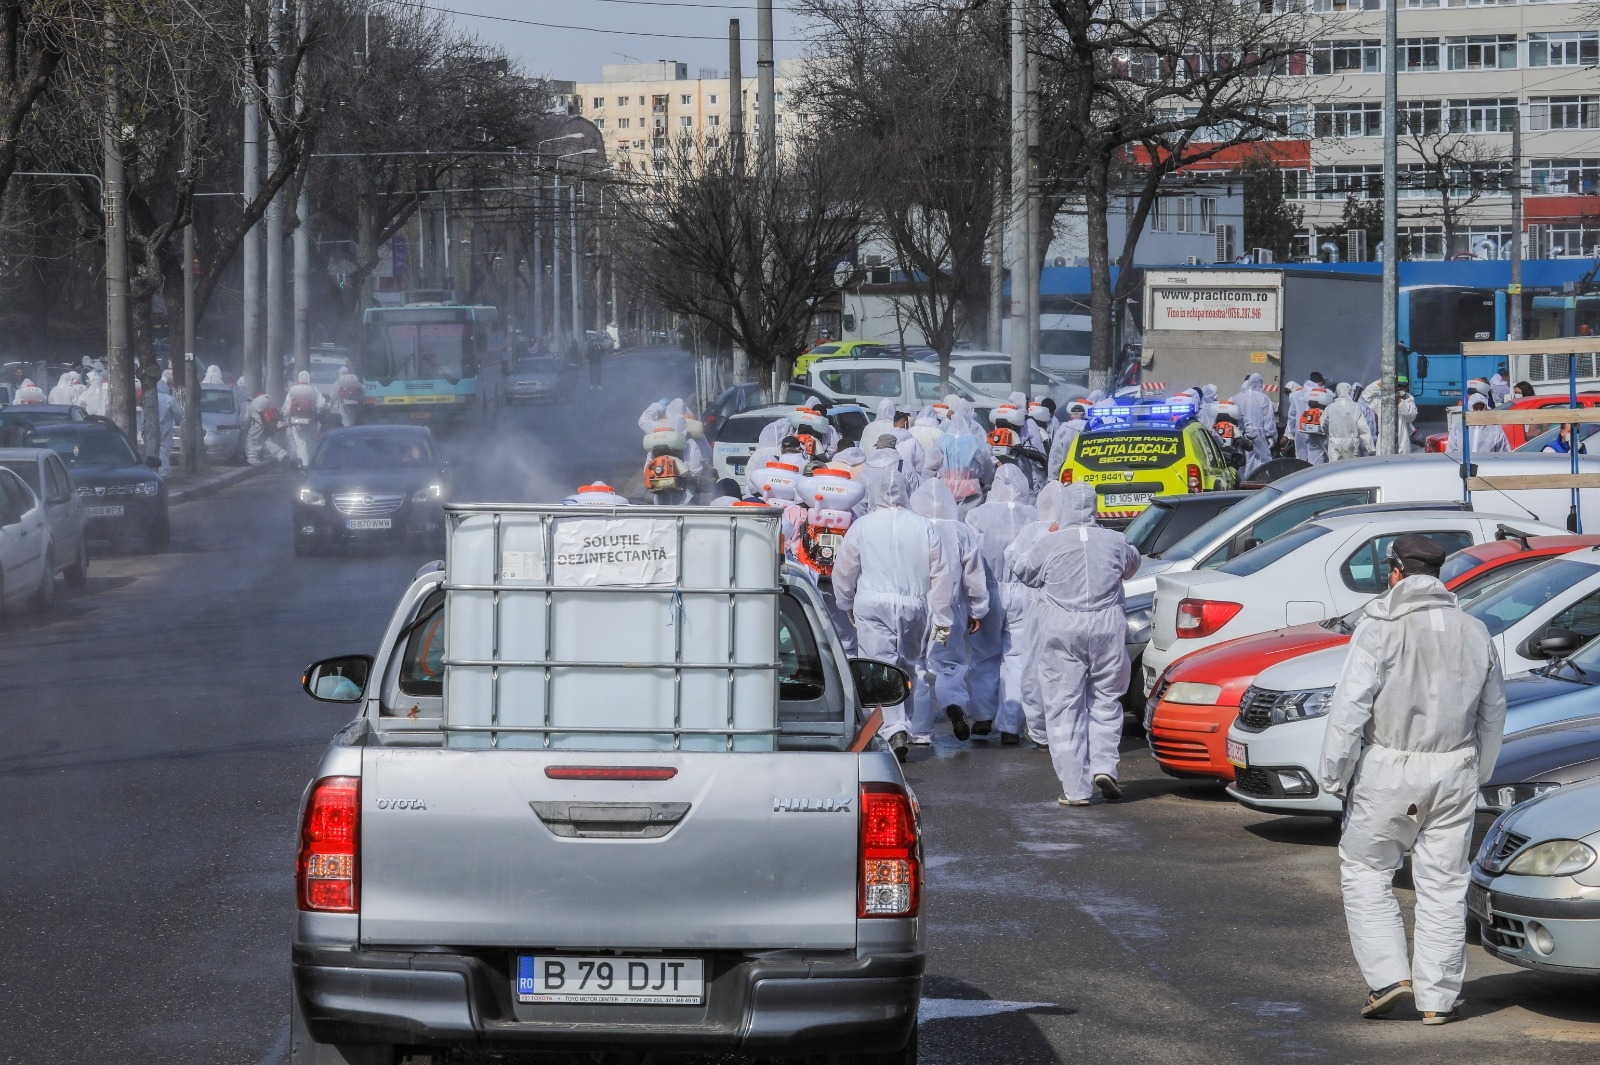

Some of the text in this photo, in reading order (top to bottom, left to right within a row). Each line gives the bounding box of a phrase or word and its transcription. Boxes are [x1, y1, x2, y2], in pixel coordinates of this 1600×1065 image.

[1161, 290, 1268, 302] www.practicom.ro
[1167, 307, 1179, 318] Vino
[1187, 307, 1204, 321] echipa
[1127, 443, 1178, 455] LOCALĂ
[1098, 456, 1147, 464] SECTOR
[1119, 494, 1132, 503] 105
[1134, 493, 1153, 502] WPX
[105, 505, 122, 514] WPX
[357, 520, 371, 528] 870
[372, 519, 391, 528] WMW
[557, 547, 668, 566] DEZINFECTANTĂ
[774, 798, 852, 812] HILUX
[520, 961, 685, 991] RO B 79 DJT
